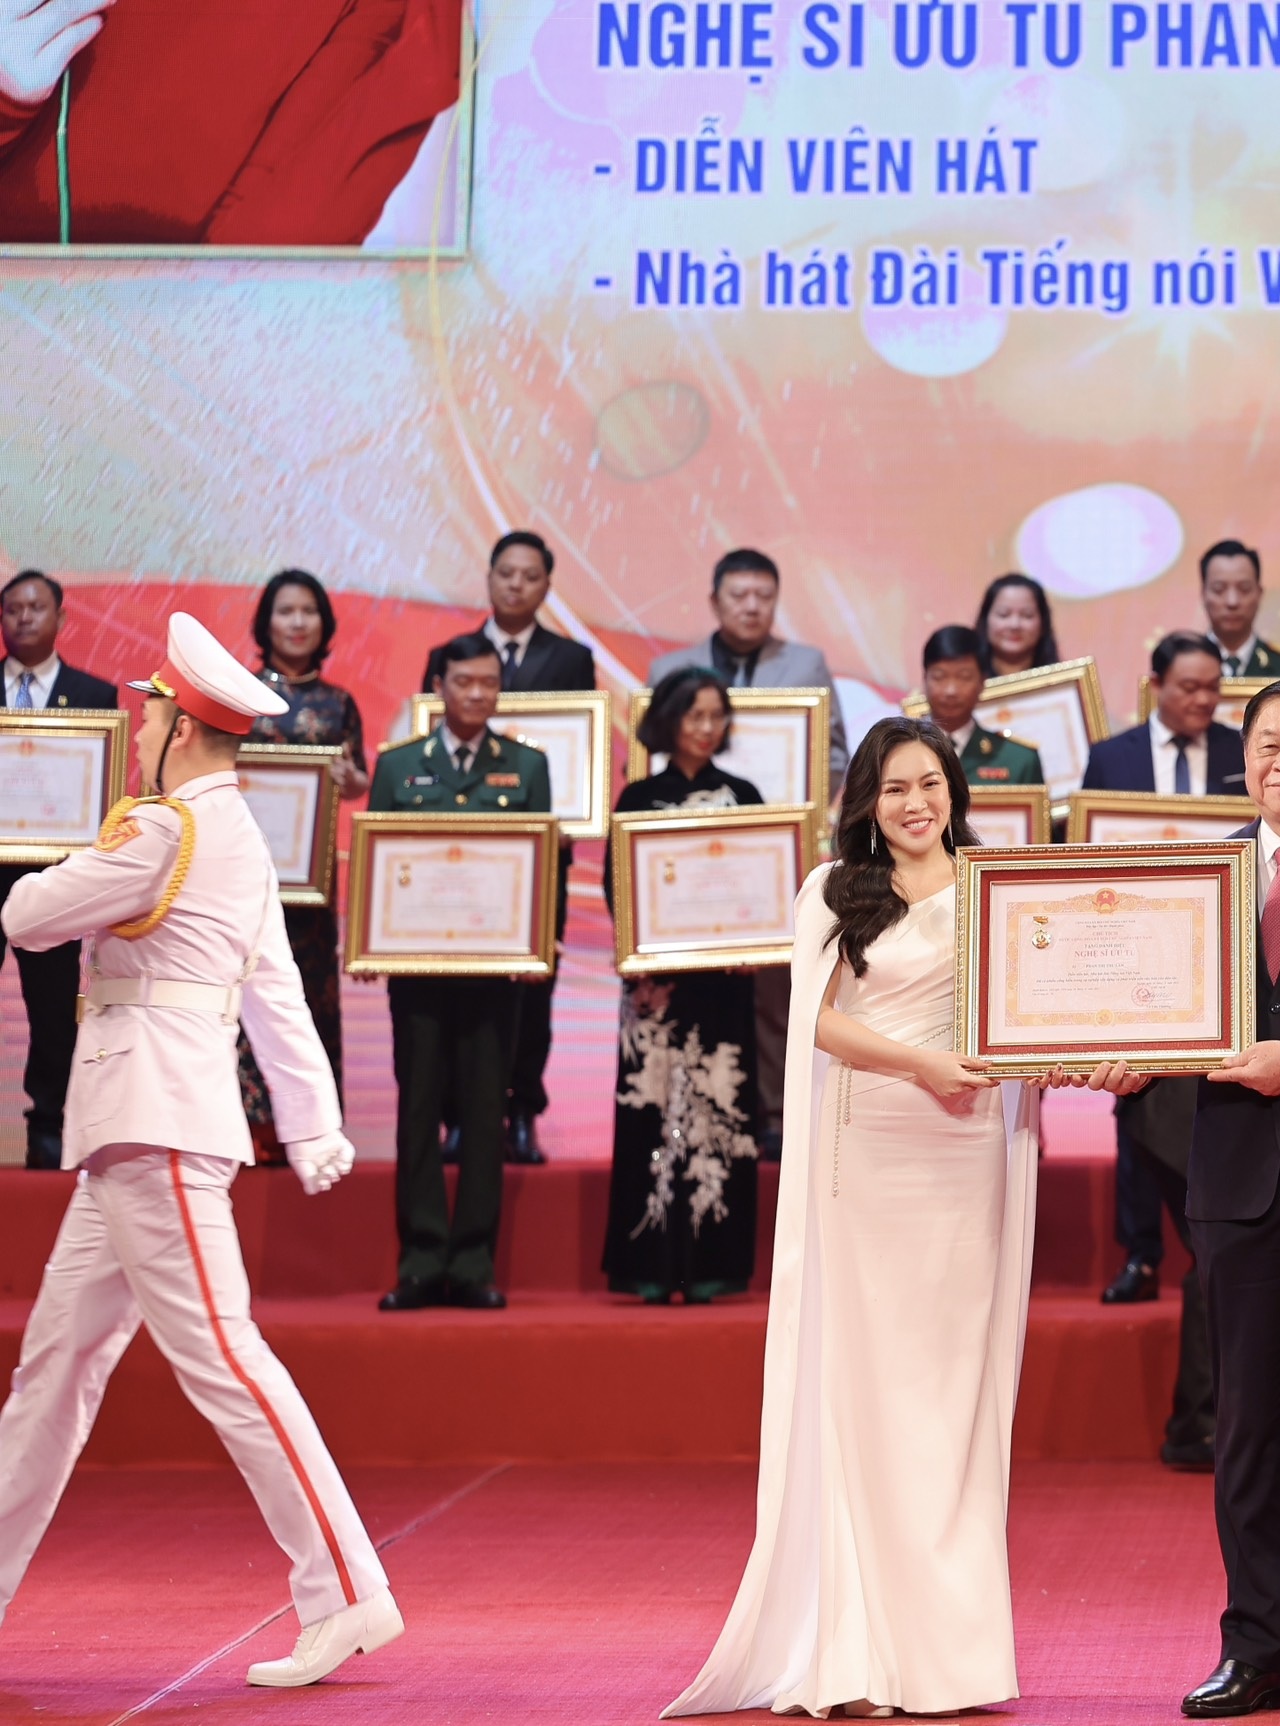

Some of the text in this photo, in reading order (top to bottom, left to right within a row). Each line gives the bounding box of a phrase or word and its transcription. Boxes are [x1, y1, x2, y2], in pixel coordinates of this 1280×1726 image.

[597, 1, 774, 84] NGHỆ
[635, 116, 764, 193] DIỄN
[786, 125, 912, 193] VIÊN
[936, 125, 1039, 193] HÁT
[636, 249, 740, 306] Nhà
[765, 249, 850, 307] hát
[868, 249, 958, 307] Đài
[981, 239, 1129, 314] Tiếng
[1153, 249, 1235, 306] nói
